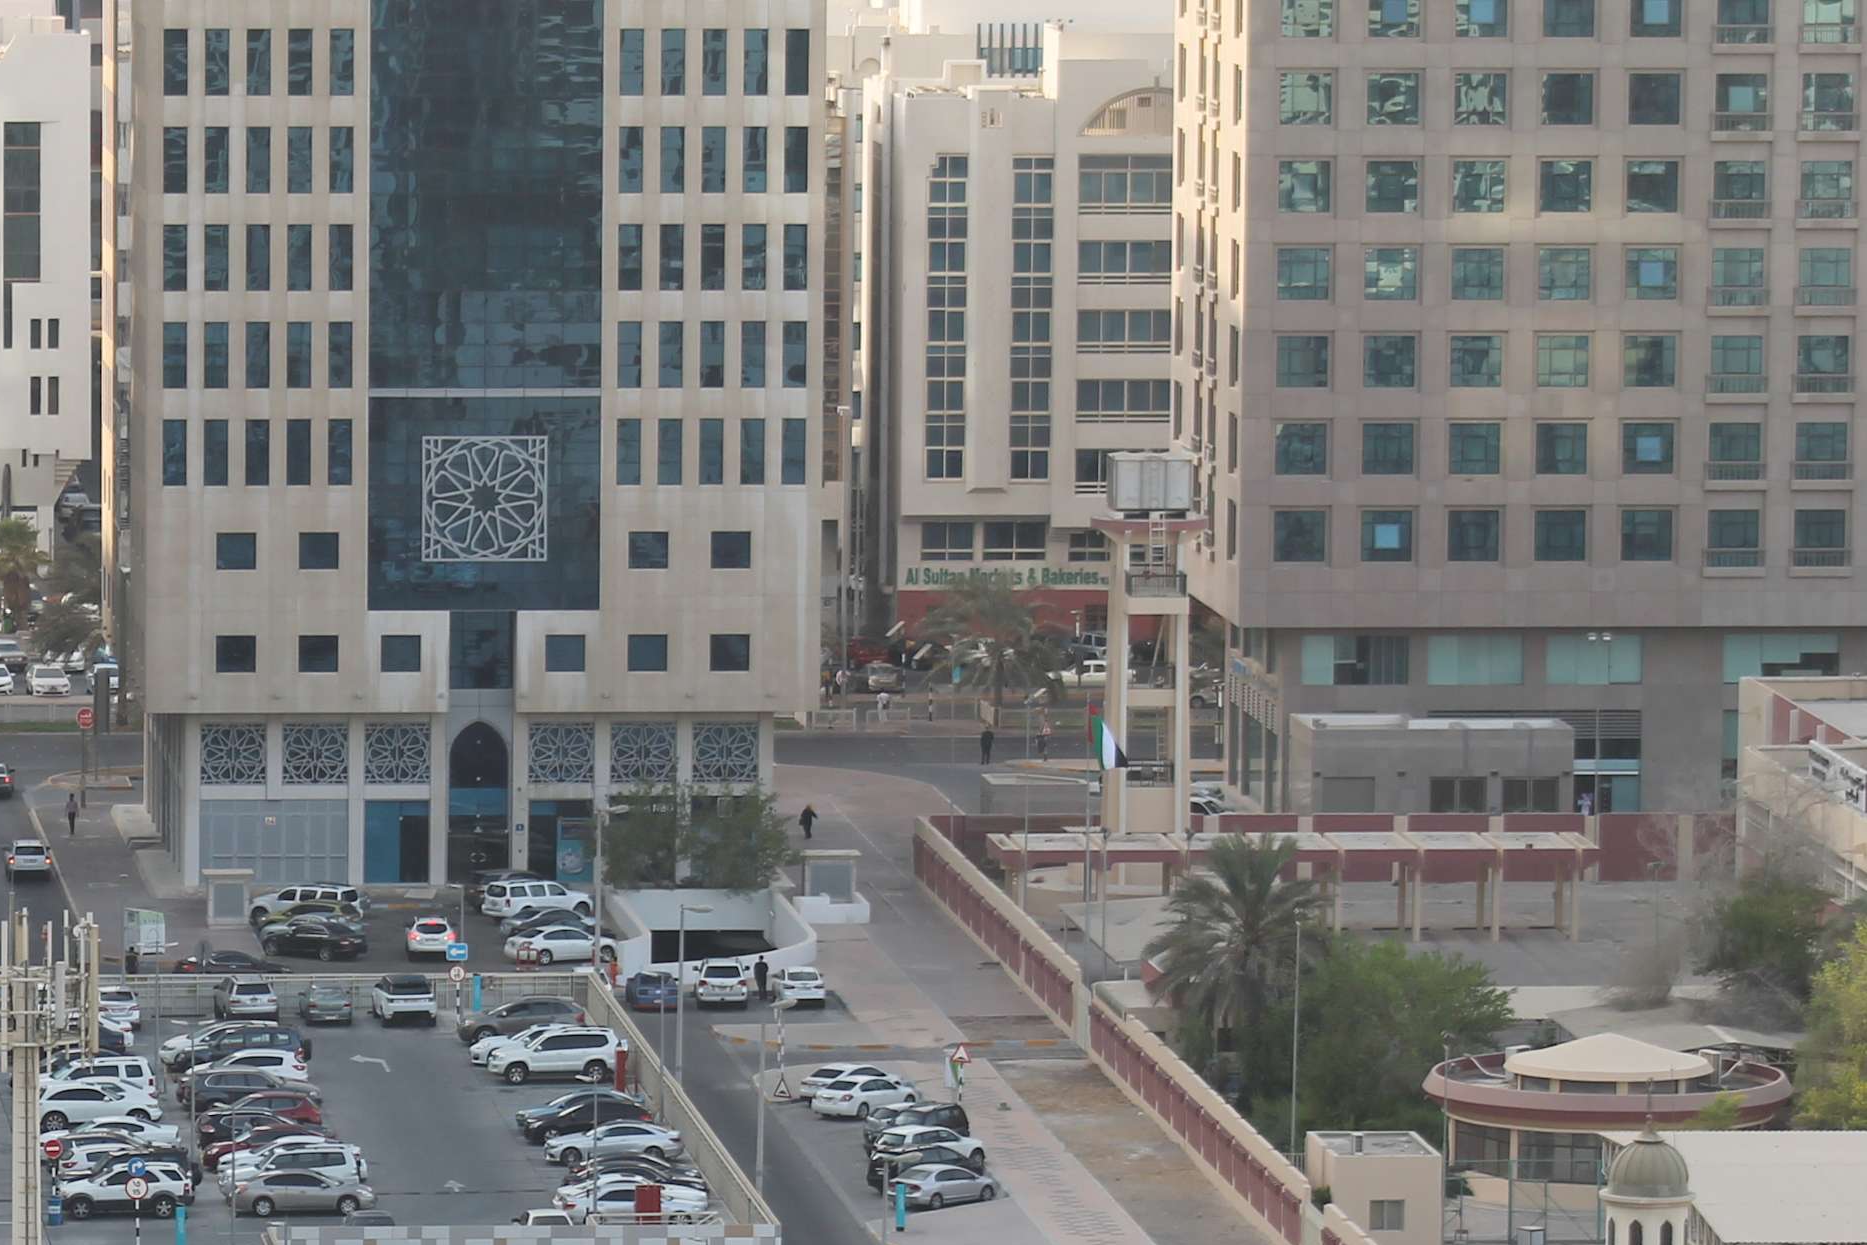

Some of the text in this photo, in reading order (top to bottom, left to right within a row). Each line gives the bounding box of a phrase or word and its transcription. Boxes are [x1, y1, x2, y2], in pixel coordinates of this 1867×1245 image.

[905, 567, 918, 585] Al
[1027, 567, 1037, 585] &
[1042, 567, 1099, 585] Bakeries
